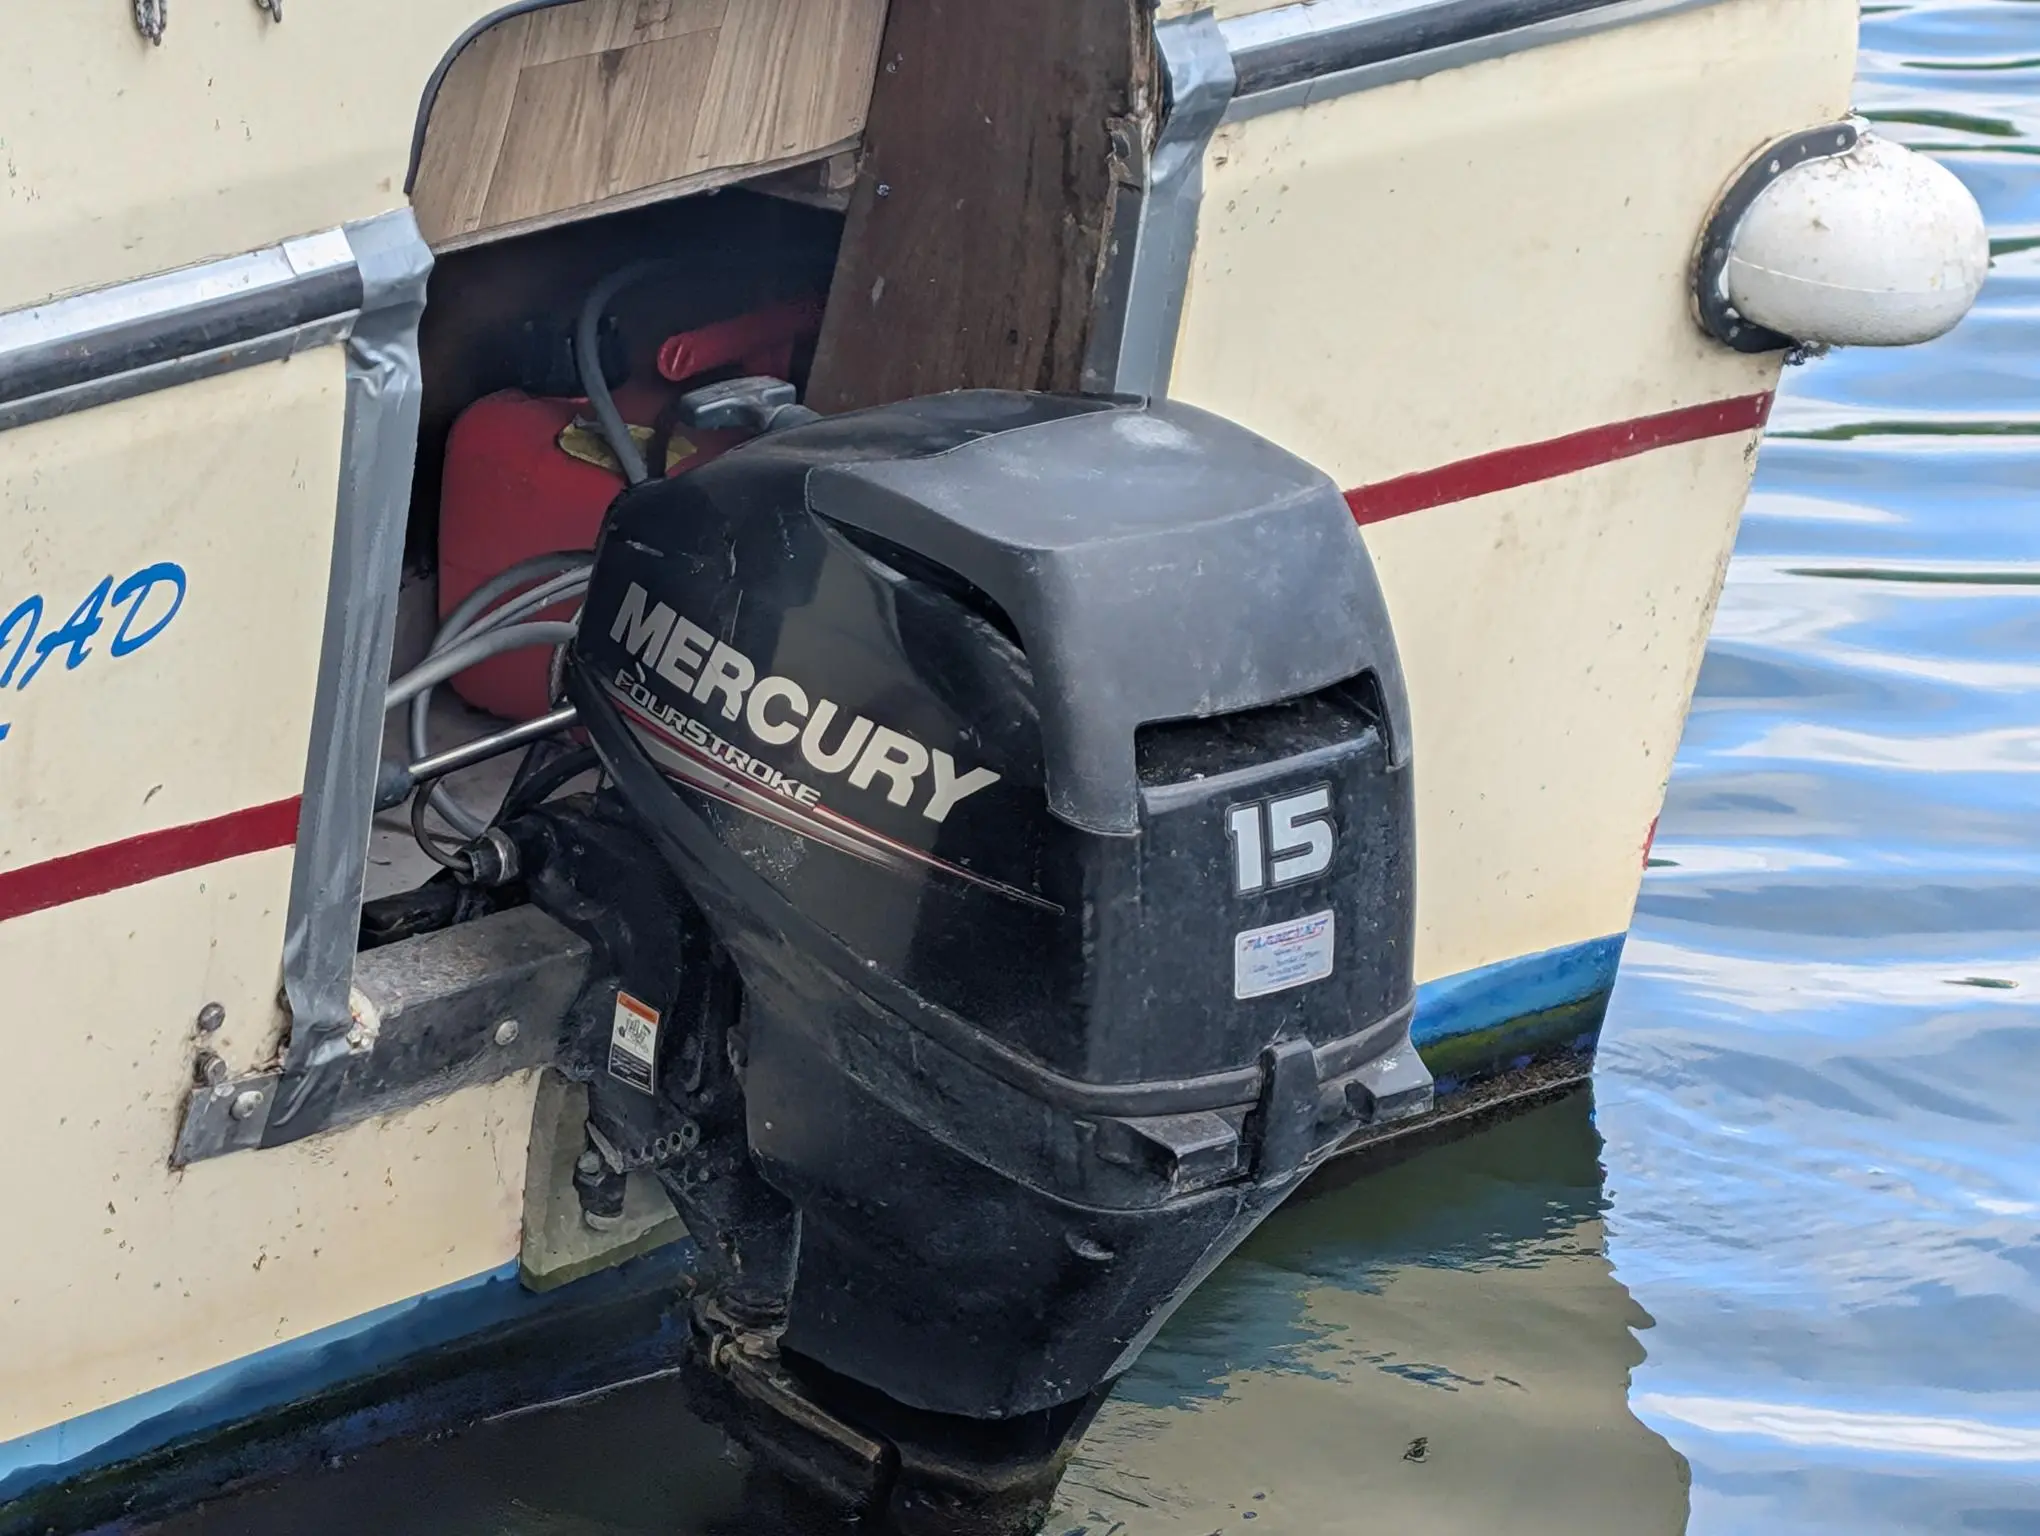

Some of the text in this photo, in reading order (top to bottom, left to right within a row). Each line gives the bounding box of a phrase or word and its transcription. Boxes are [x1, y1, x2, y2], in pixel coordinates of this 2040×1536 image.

[609, 582, 1001, 823] MERCURY
[613, 668, 821, 806] FOURSTROKE
[1230, 786, 1335, 893] 15
